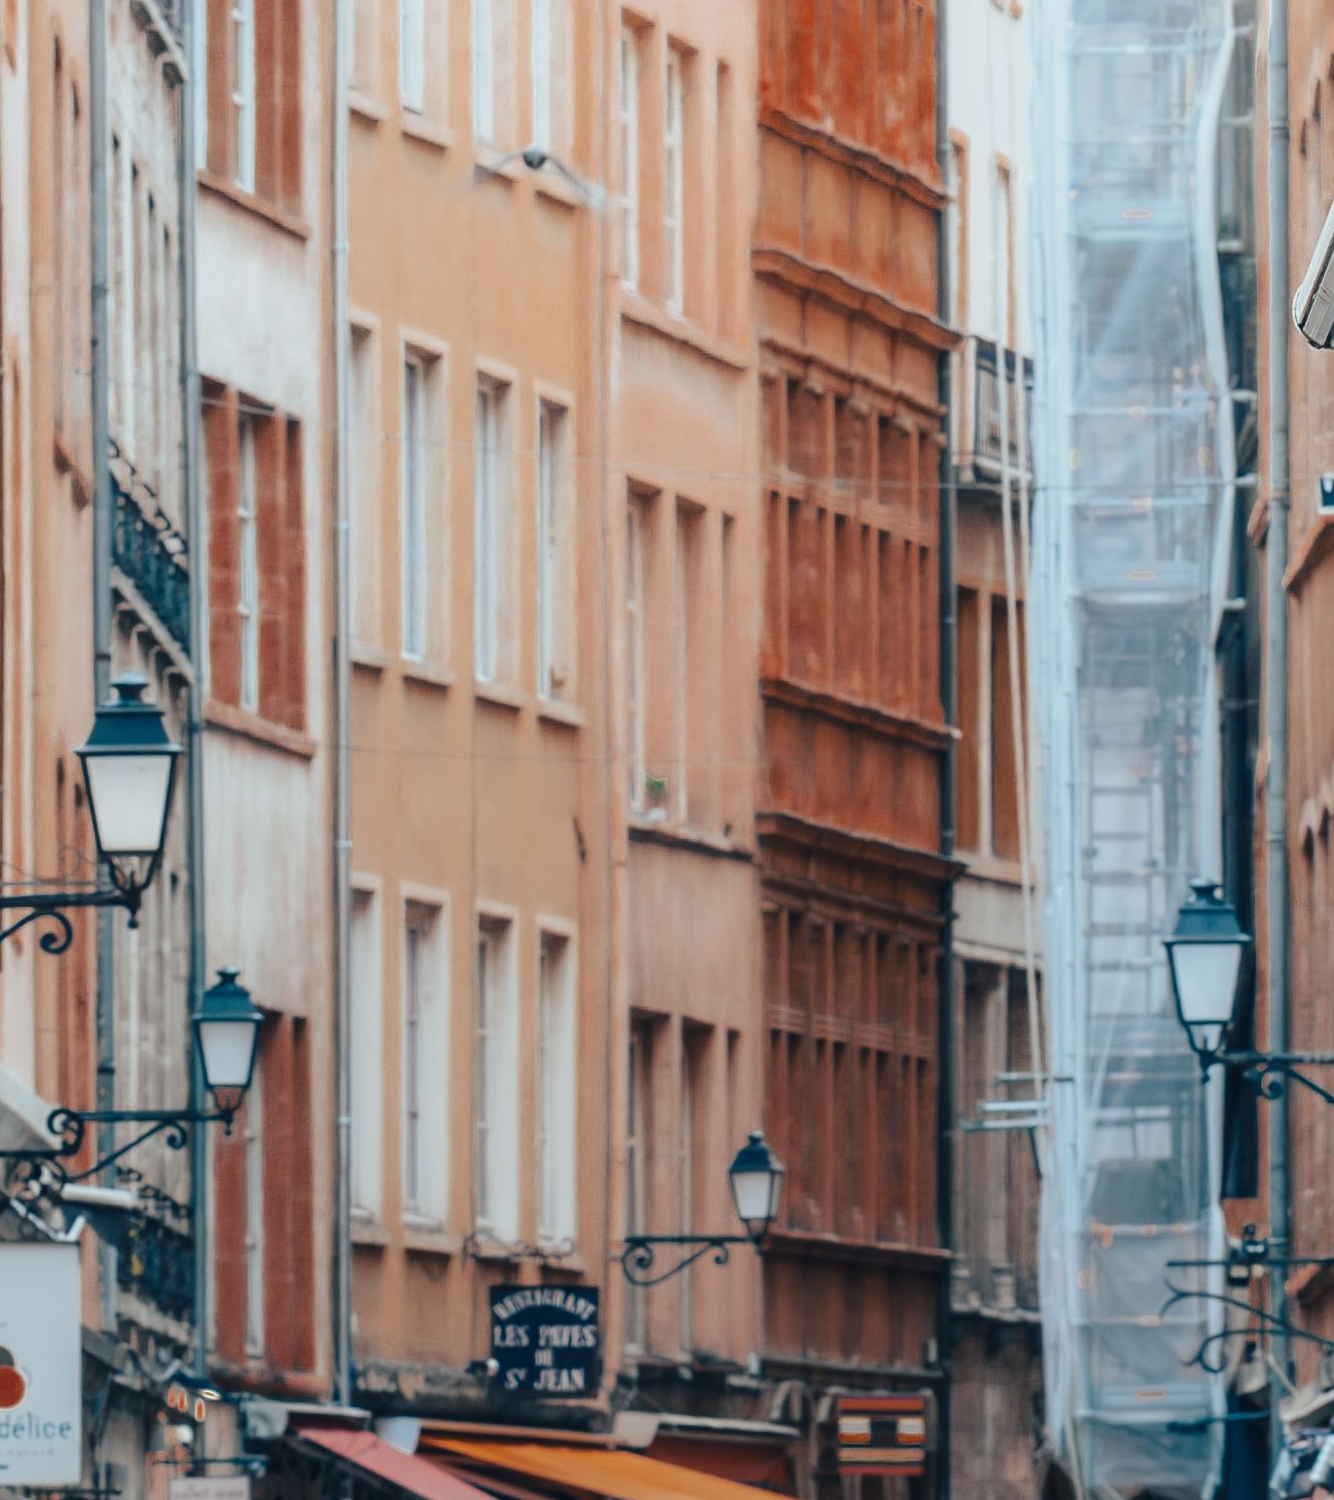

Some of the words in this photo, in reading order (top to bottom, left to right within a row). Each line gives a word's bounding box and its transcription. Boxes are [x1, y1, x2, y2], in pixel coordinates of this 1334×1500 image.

[492, 1288, 596, 1321] RESTAURANT
[493, 1324, 530, 1347] LES
[533, 1367, 585, 1392] JEAN
